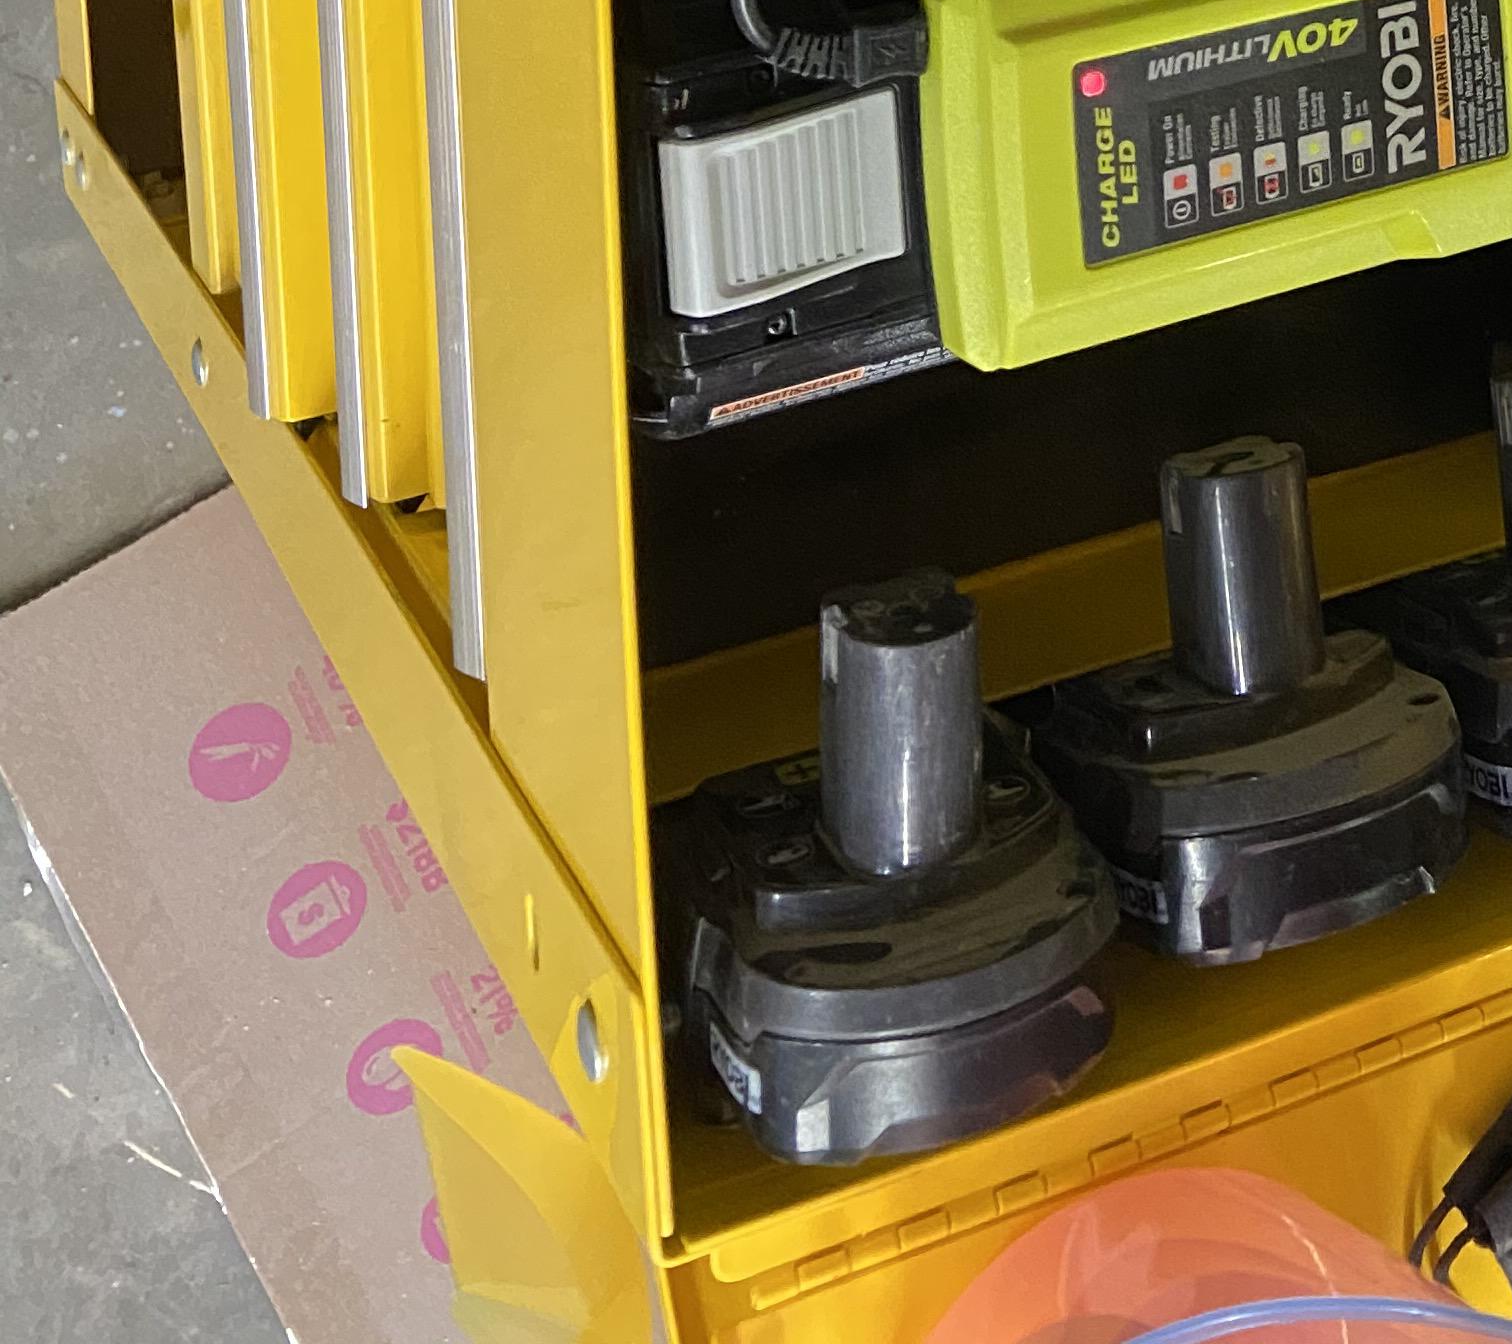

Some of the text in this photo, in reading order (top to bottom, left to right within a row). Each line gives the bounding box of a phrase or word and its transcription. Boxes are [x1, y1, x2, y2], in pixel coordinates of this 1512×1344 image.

[1146, 32, 1272, 80] LITHIUM
[1379, 0, 1427, 174] RYOBI
[1431, 31, 1452, 107] WARNING
[1295, 84, 1311, 132] Charging
[1092, 103, 1122, 250] CHARGE
[1117, 136, 1140, 208] LED
